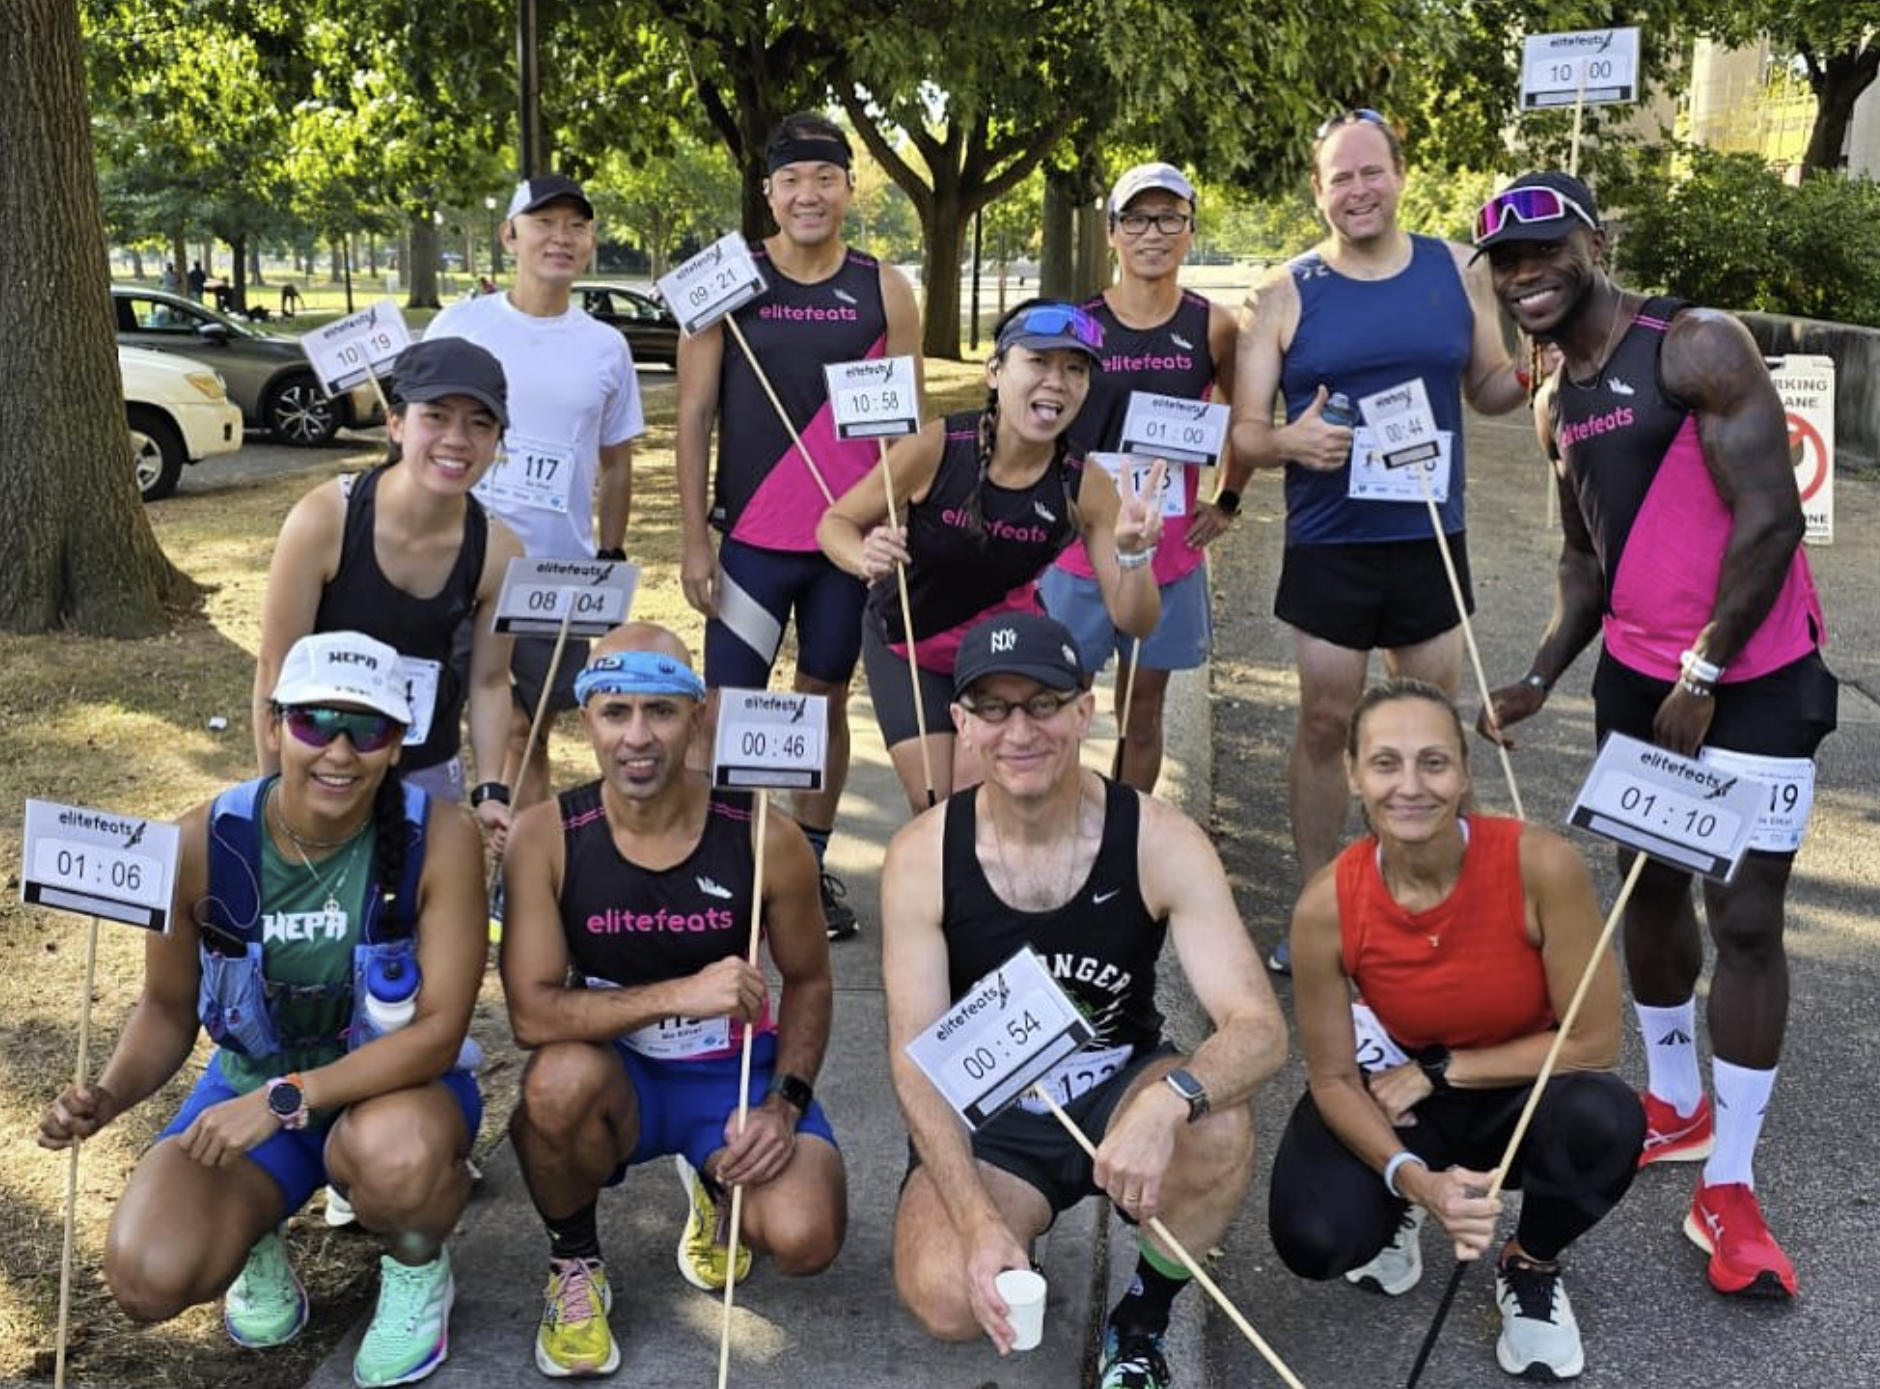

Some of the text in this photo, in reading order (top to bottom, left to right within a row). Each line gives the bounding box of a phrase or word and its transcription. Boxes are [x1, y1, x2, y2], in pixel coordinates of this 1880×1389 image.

[759, 303, 858, 321] elitefeats
[1102, 353, 1192, 372] elitefeats
[526, 455, 559, 481] 117
[942, 507, 1047, 542] elifeats
[536, 561, 601, 577] elitefeats
[528, 590, 605, 613] 08 04
[990, 628, 1018, 654] NY
[1640, 752, 1721, 790] elitefeats
[59, 811, 132, 836] elitefeats
[586, 907, 734, 935] elitefeats
[936, 986, 998, 1042] elitefeats
